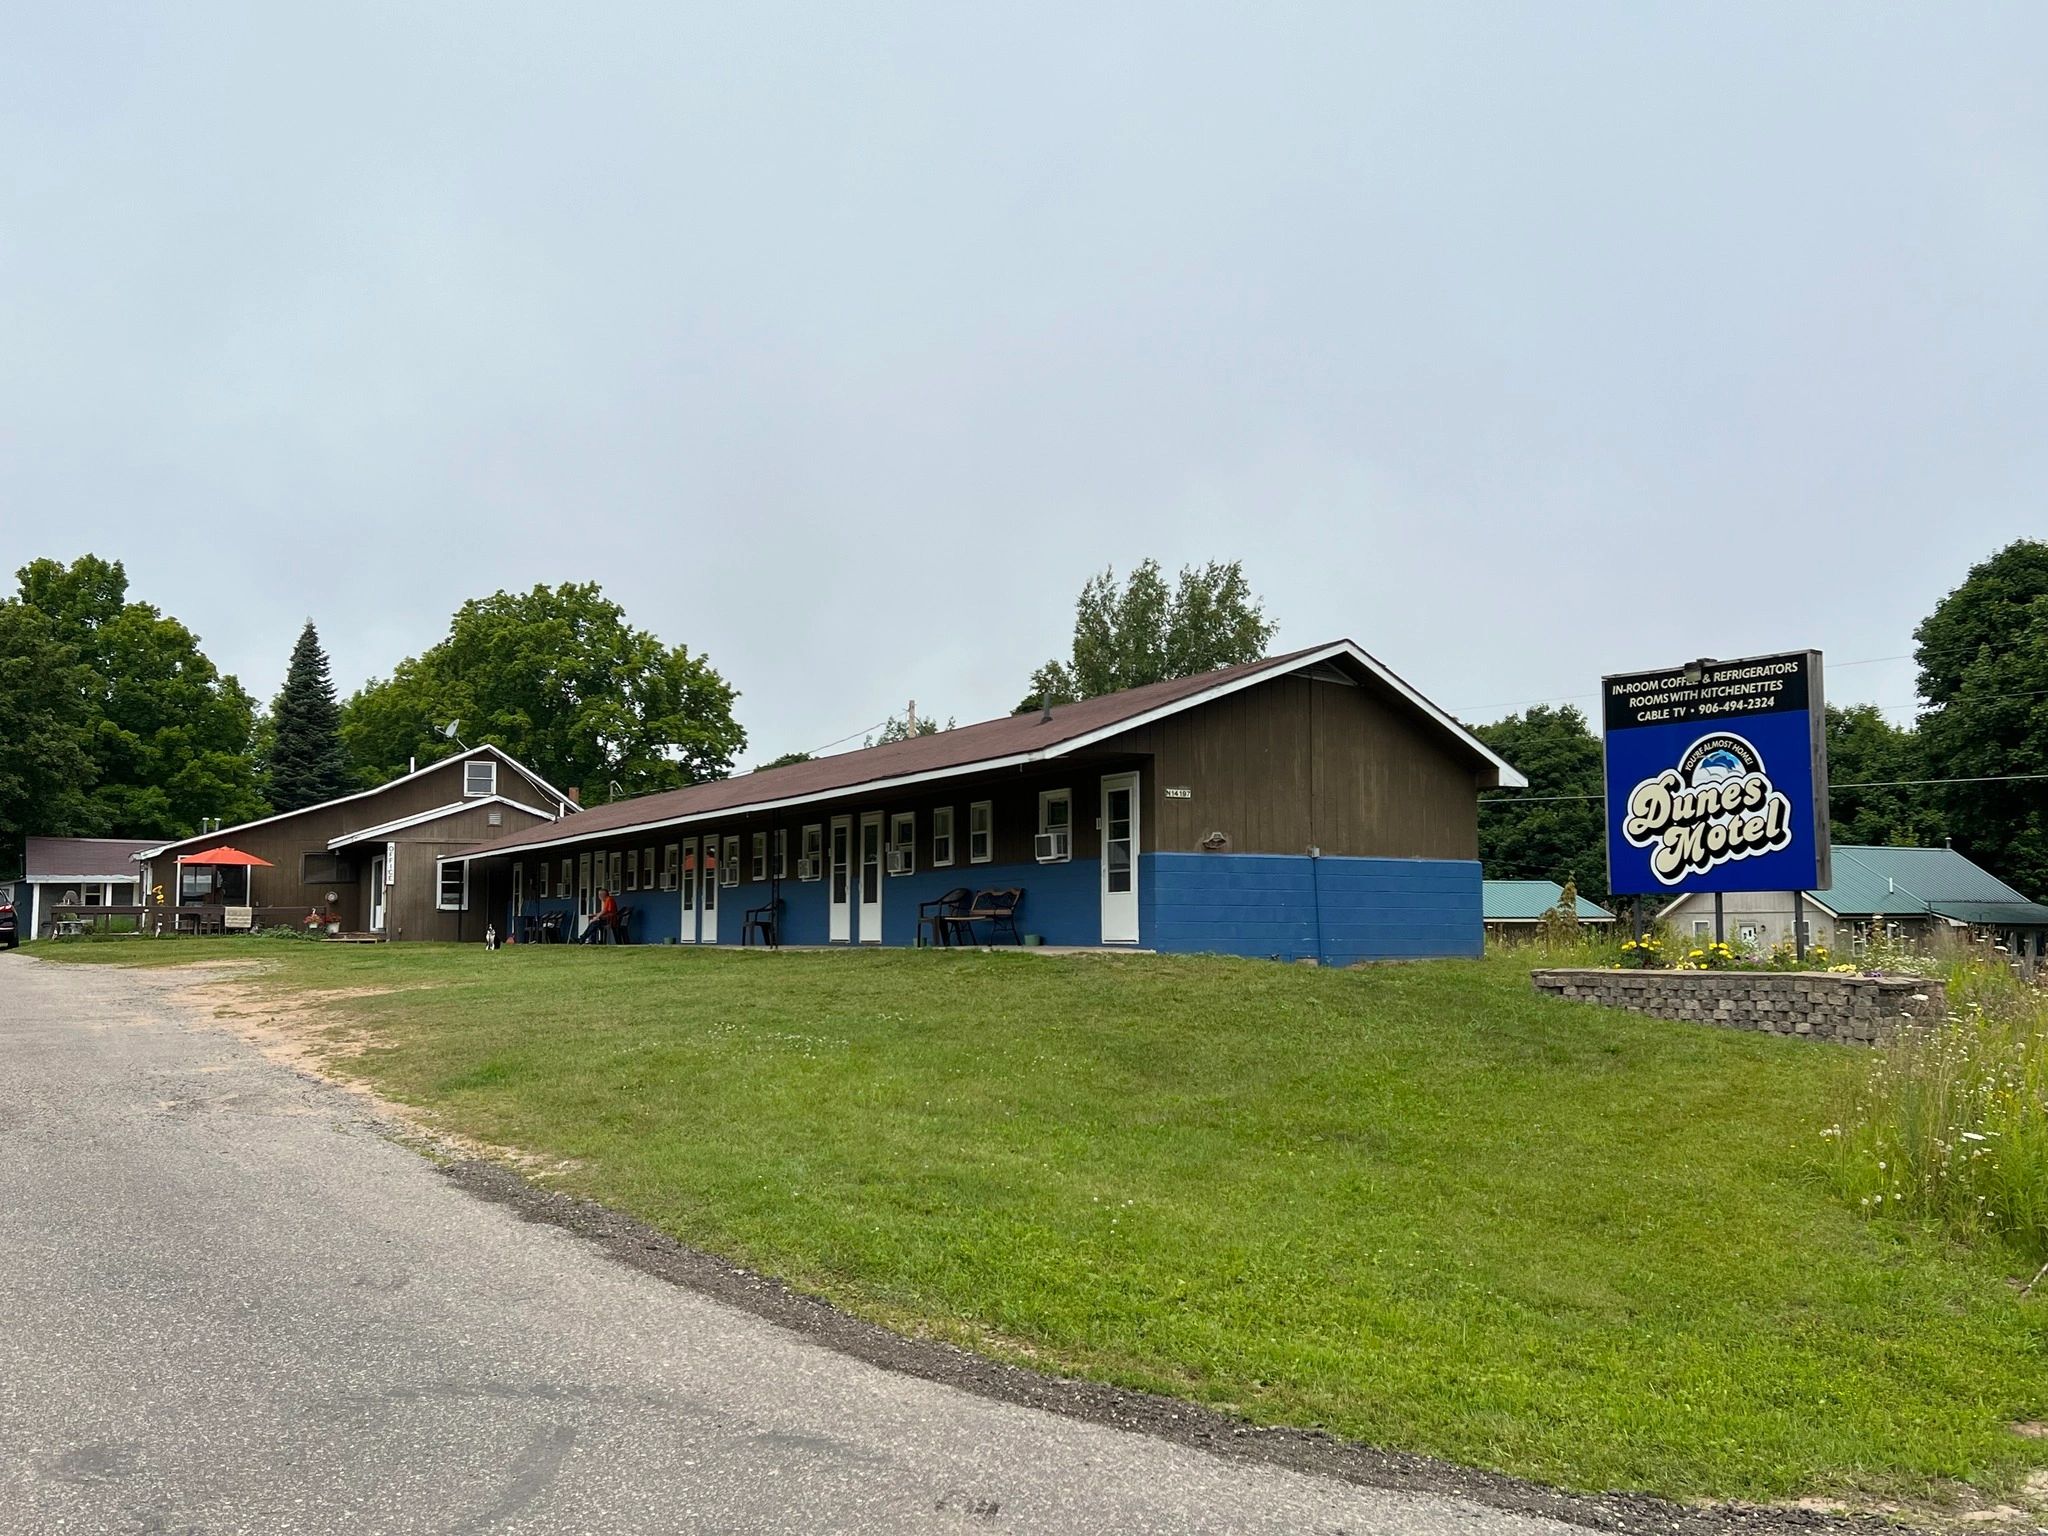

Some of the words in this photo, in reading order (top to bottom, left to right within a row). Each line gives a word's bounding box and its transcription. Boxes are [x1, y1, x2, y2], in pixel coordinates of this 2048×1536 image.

[1612, 680, 1659, 695] IN-ROOM
[1702, 673, 1711, 684] &
[1713, 661, 1799, 682] REFRIGERATORS
[1629, 693, 1669, 708] ROOMS
[1670, 689, 1699, 702] WITH
[1700, 680, 1783, 699] KITCHENETTES
[1637, 707, 1670, 722] CABLE
[1673, 706, 1687, 718] TV
[1698, 696, 1775, 714] 906-494-2324
[1703, 740, 1734, 752] ALMOST
[1731, 745, 1754, 765] HOME!
[1627, 773, 1765, 838] Dunes
[1655, 796, 1783, 876] Motel
